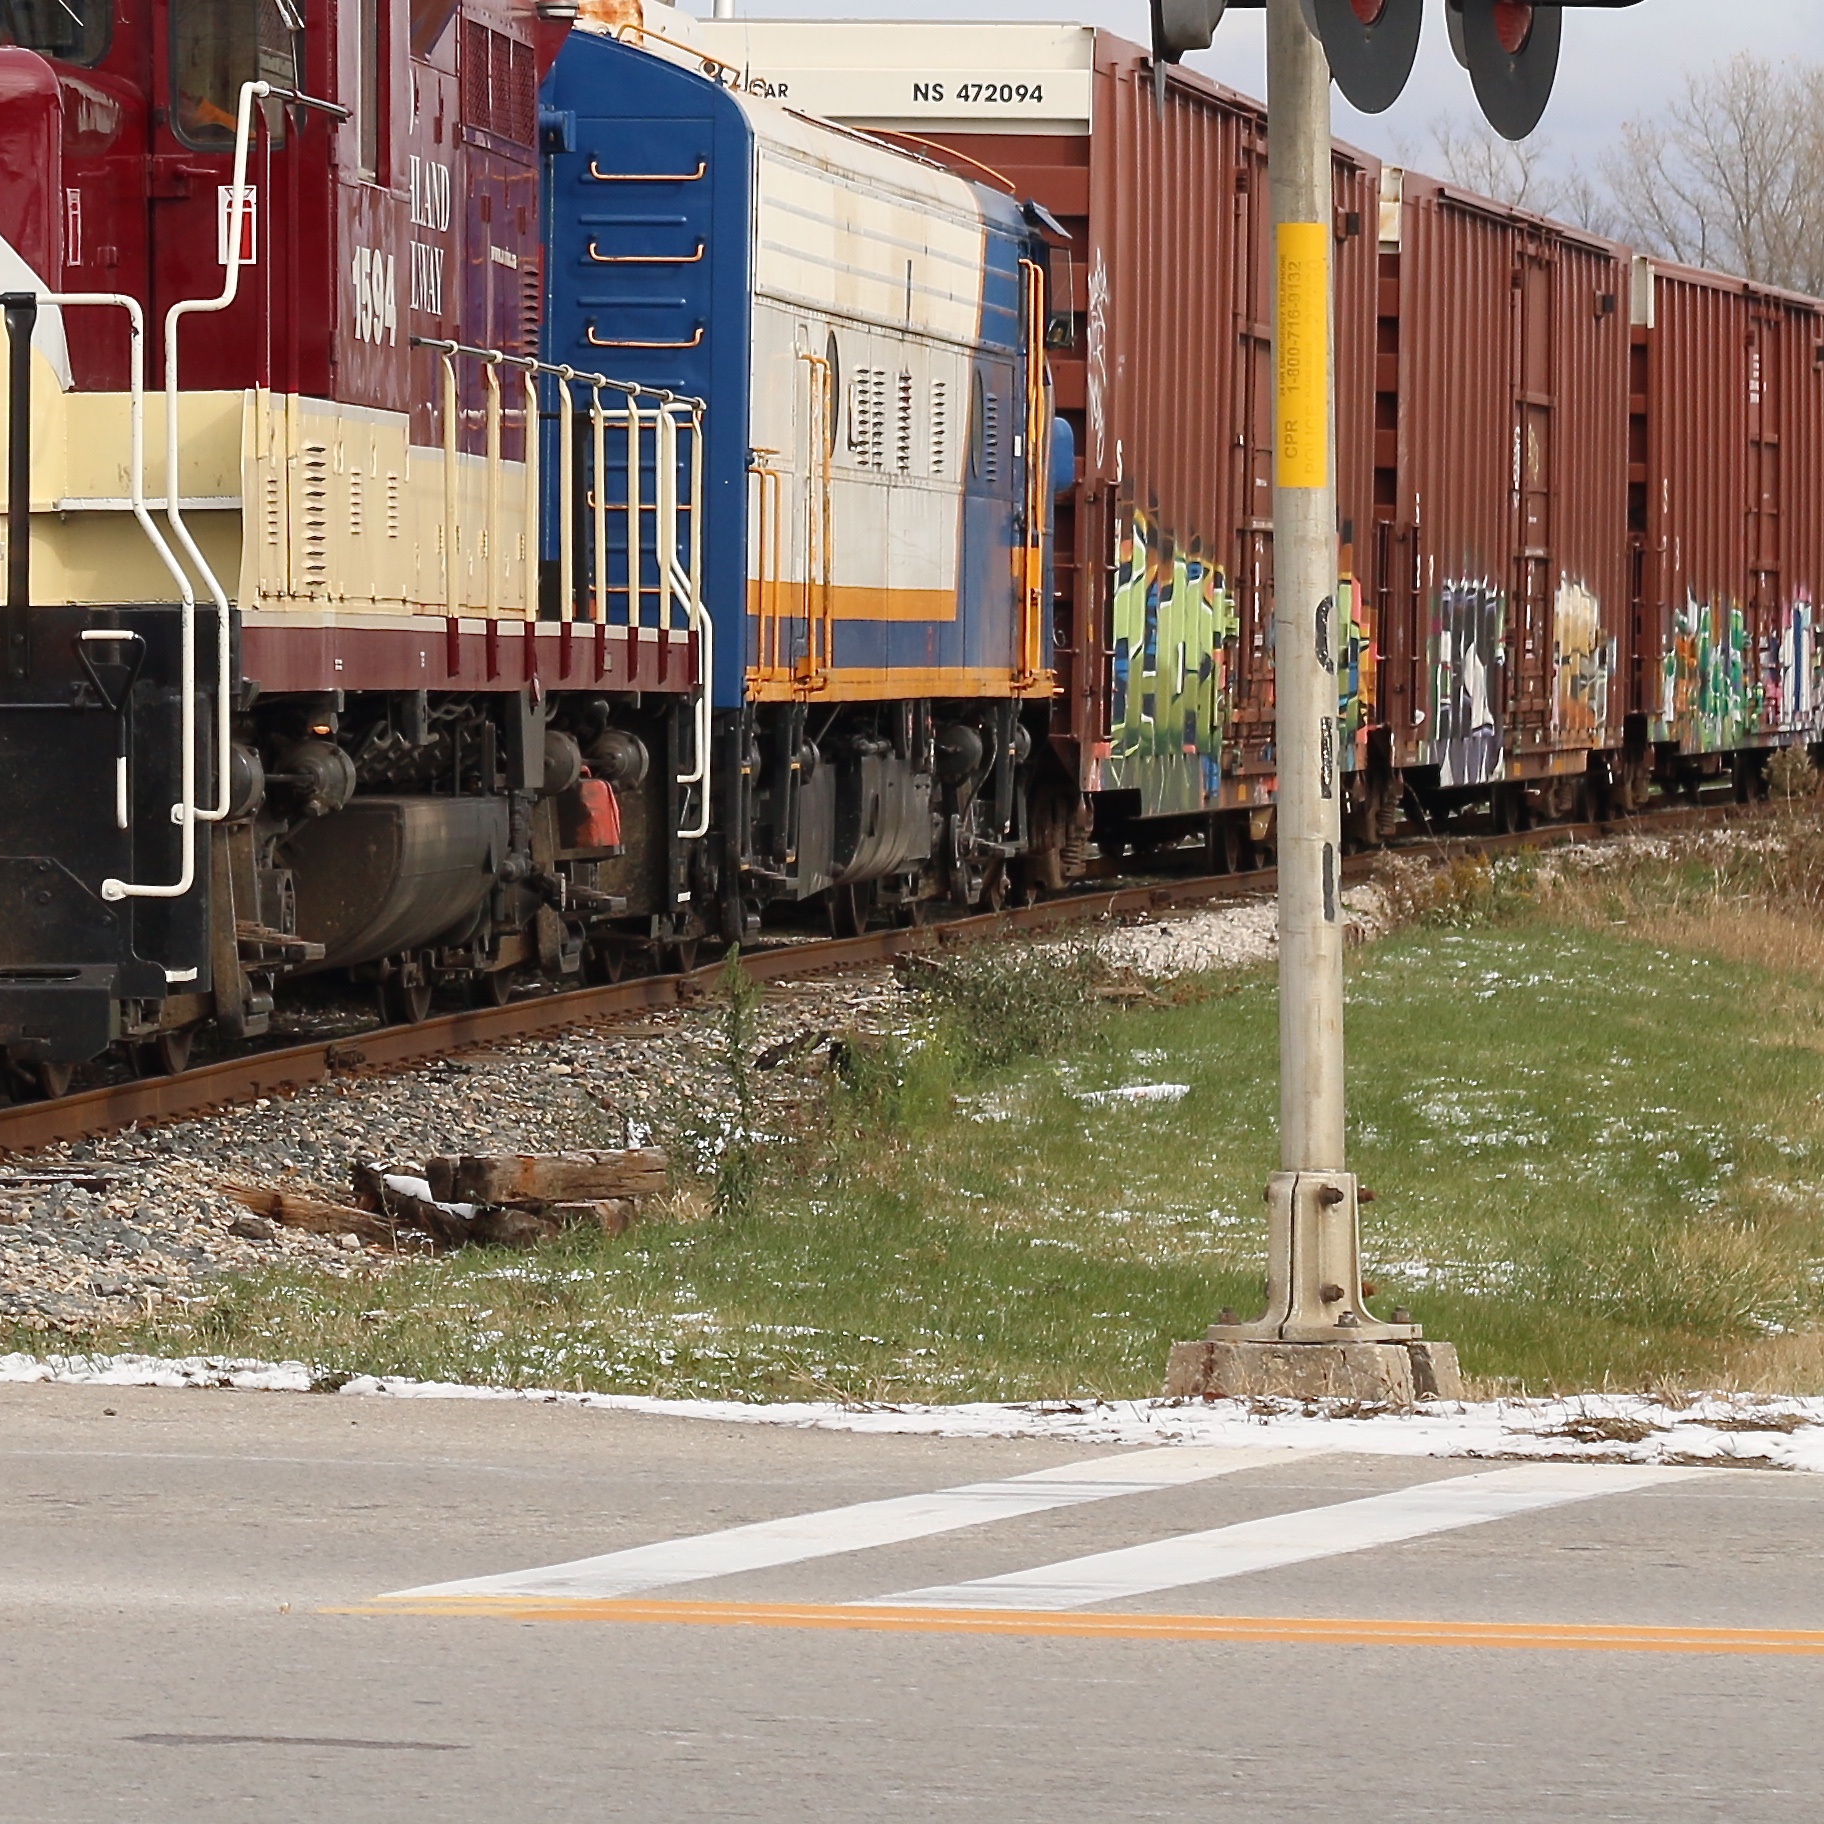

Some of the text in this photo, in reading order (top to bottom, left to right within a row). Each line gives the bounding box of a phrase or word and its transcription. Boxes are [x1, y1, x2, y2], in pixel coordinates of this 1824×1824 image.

[912, 83, 1043, 103] NS 472094
[352, 246, 397, 347] 1594
[1286, 261, 1301, 394] 1-800-716-9132
[1284, 420, 1298, 459] CPR
